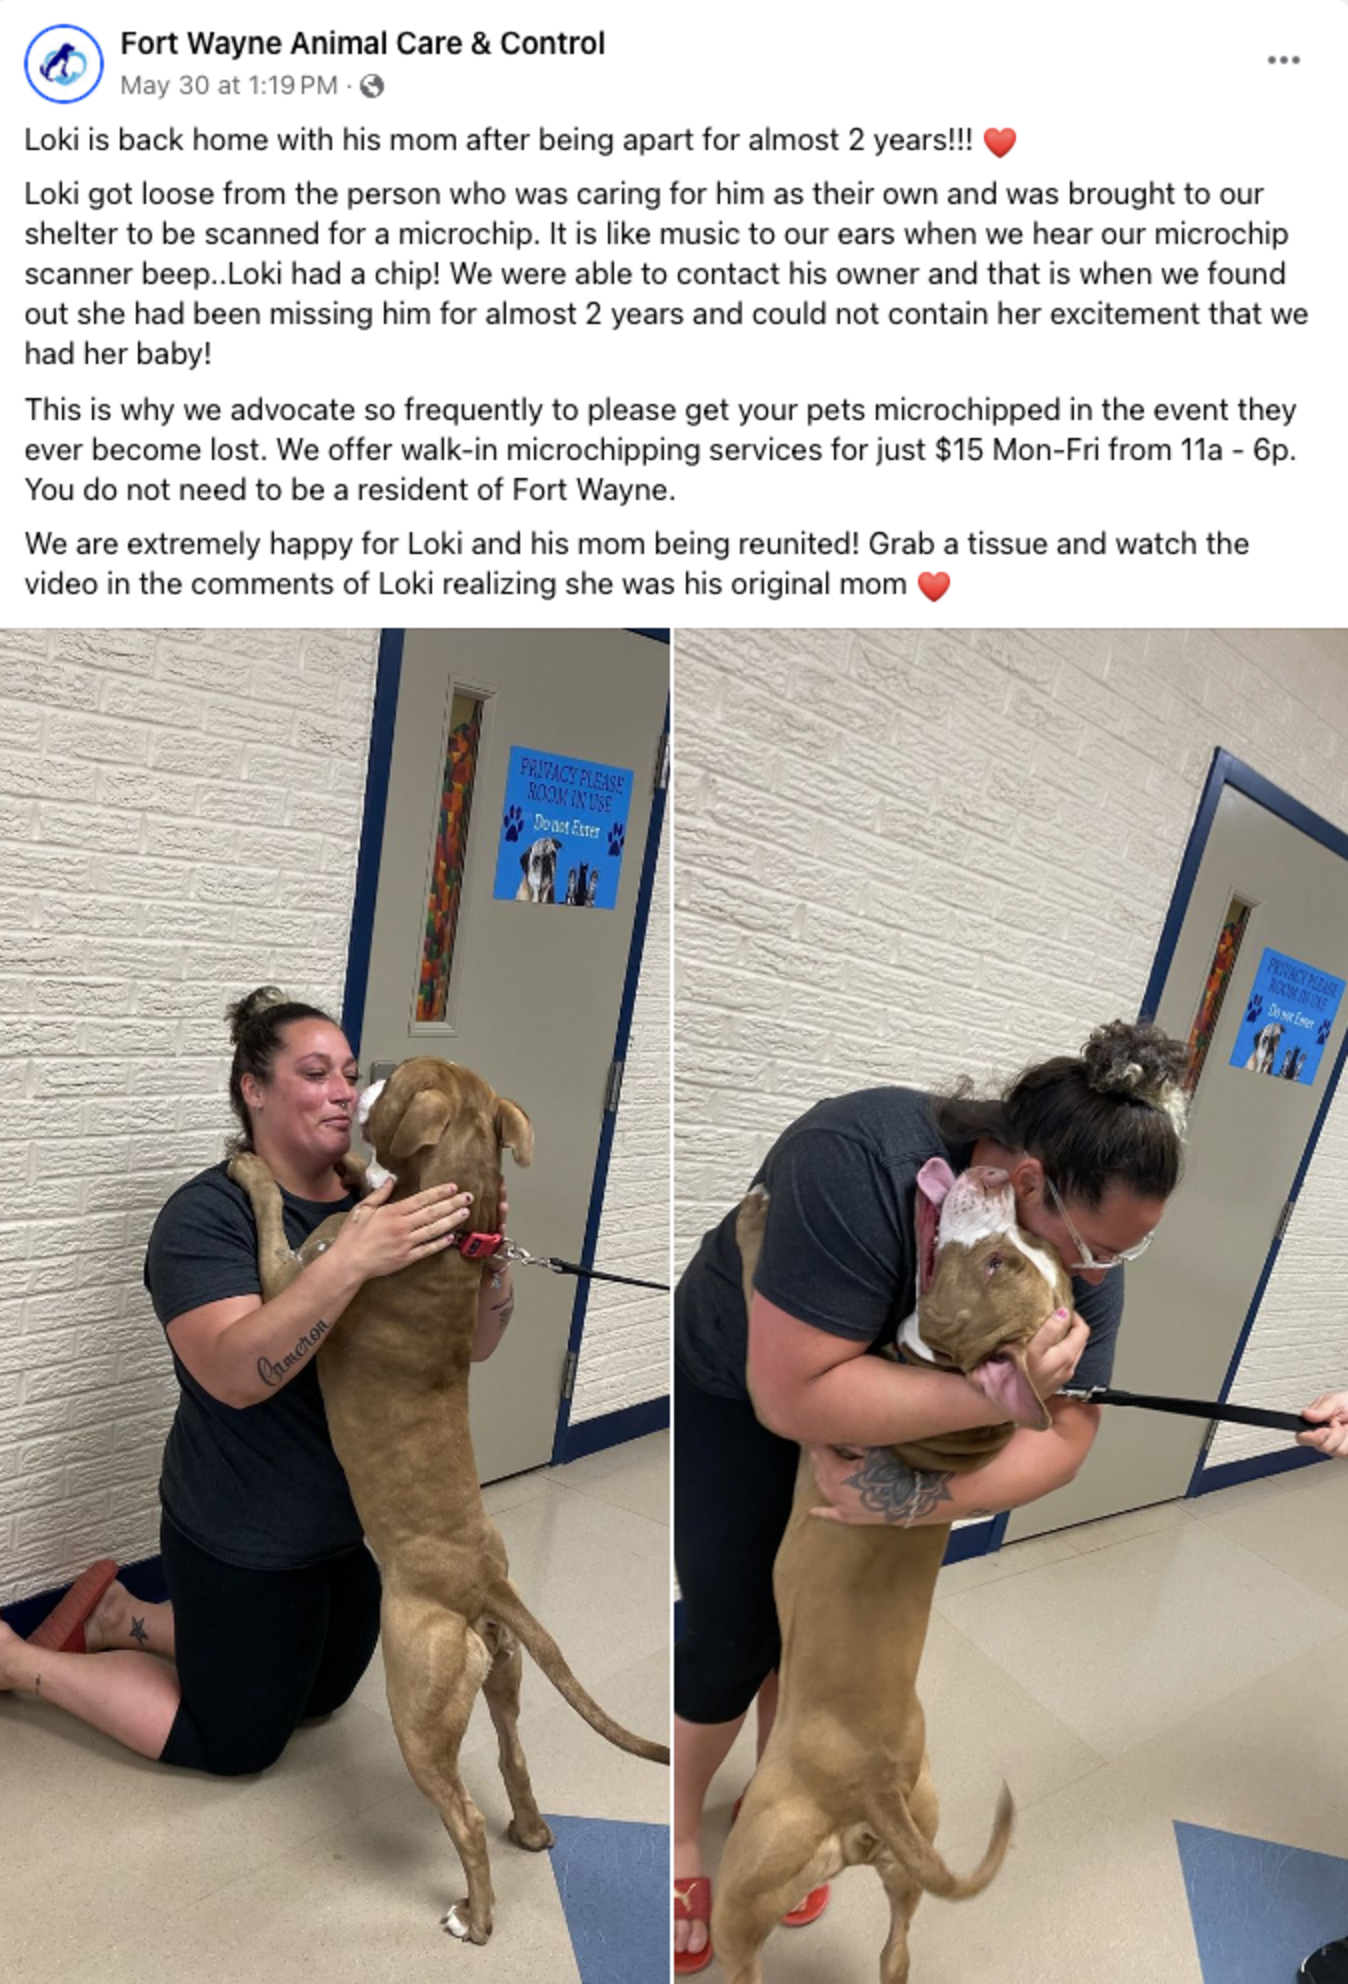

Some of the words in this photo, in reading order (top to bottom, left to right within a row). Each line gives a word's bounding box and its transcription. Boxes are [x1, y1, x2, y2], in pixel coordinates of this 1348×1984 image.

[520, 757, 578, 785] PRIVACY
[579, 769, 625, 795] PLEASE
[528, 781, 568, 805] ROOM
[571, 790, 588, 809] IN
[589, 793, 613, 813] USE
[533, 813, 551, 831] Do
[551, 819, 569, 835] not
[257, 1319, 329, 1387] Cameron
